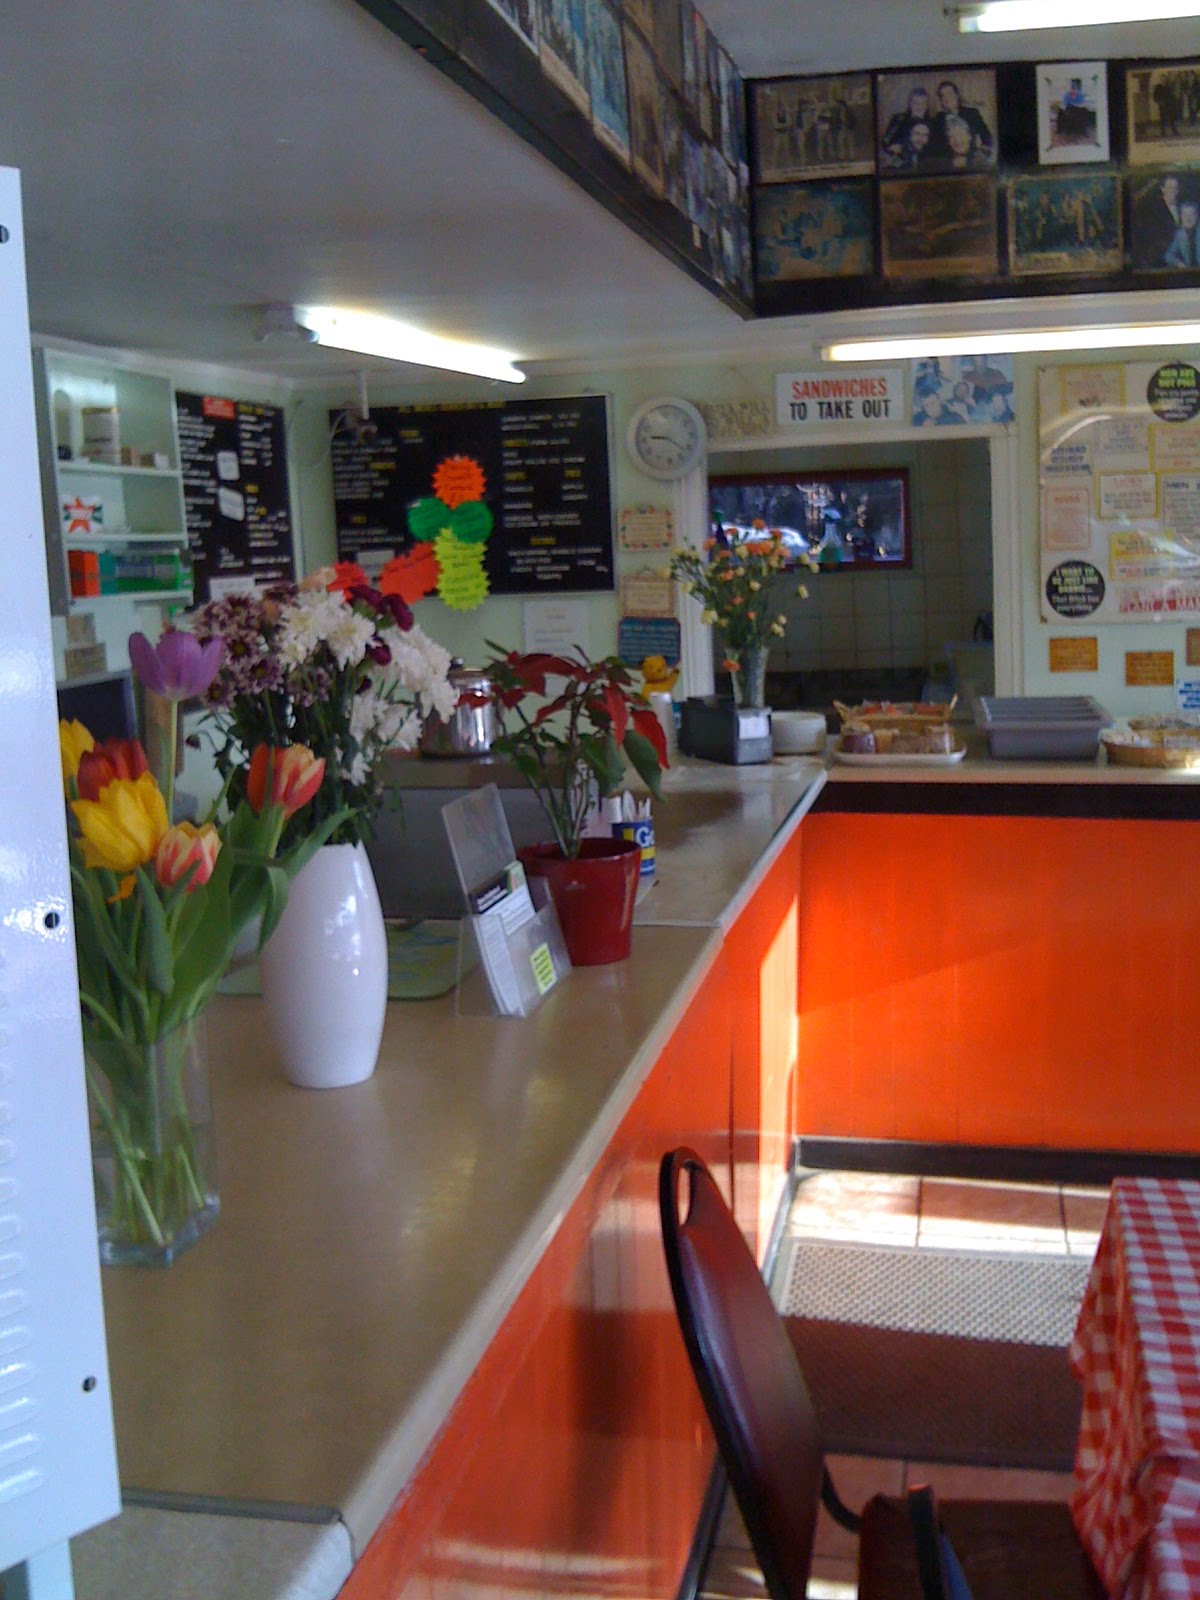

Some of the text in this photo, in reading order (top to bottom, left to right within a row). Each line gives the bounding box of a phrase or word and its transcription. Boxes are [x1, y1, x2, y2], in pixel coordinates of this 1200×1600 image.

[792, 377, 887, 400] SANDWICHES
[790, 399, 891, 420] TO TAKE OUT
